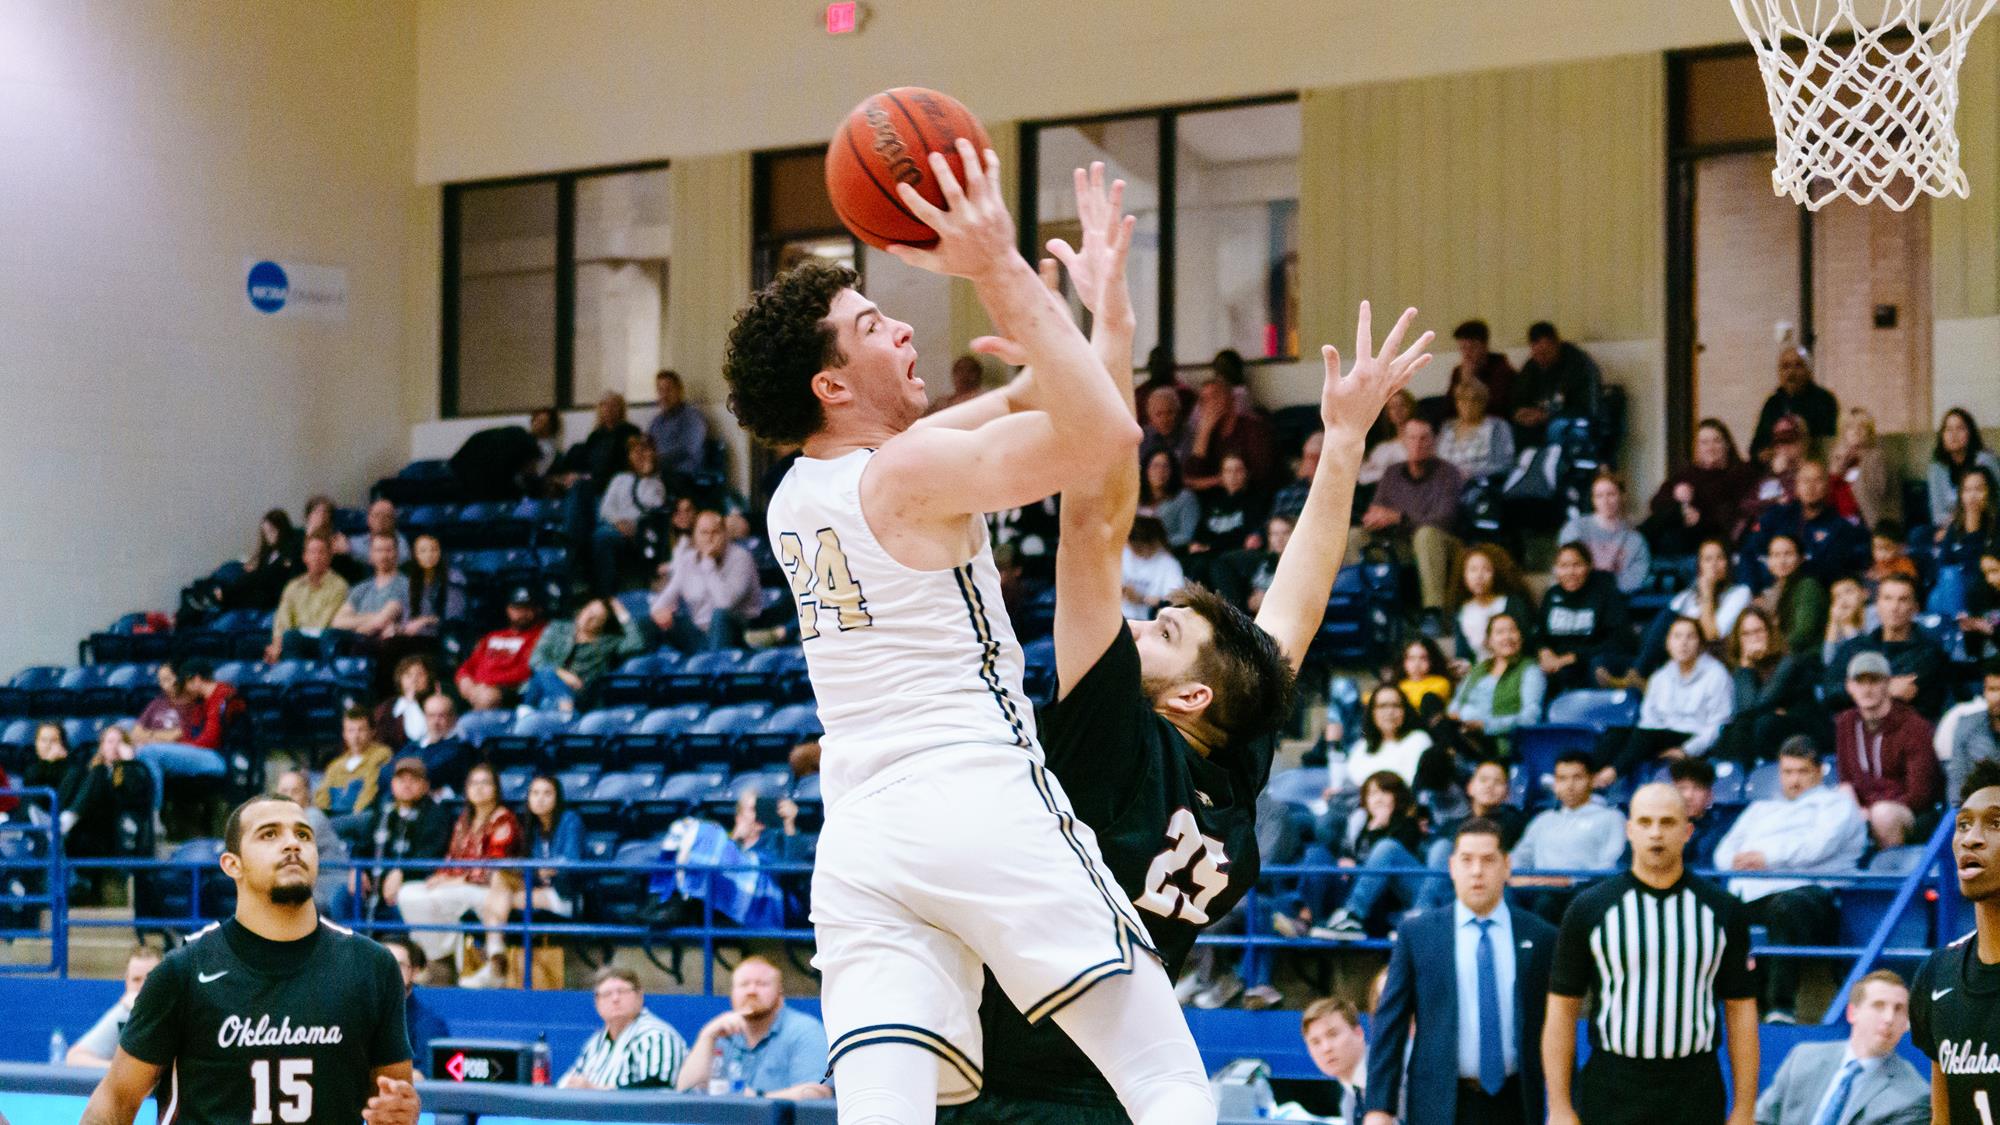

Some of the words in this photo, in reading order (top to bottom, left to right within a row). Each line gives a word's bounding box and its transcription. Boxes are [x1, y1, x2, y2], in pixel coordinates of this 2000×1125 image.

[779, 527, 873, 641] 24
[1133, 808, 1231, 925] 25
[217, 1013, 343, 1048] Oklahoma
[250, 1058, 314, 1124] 15
